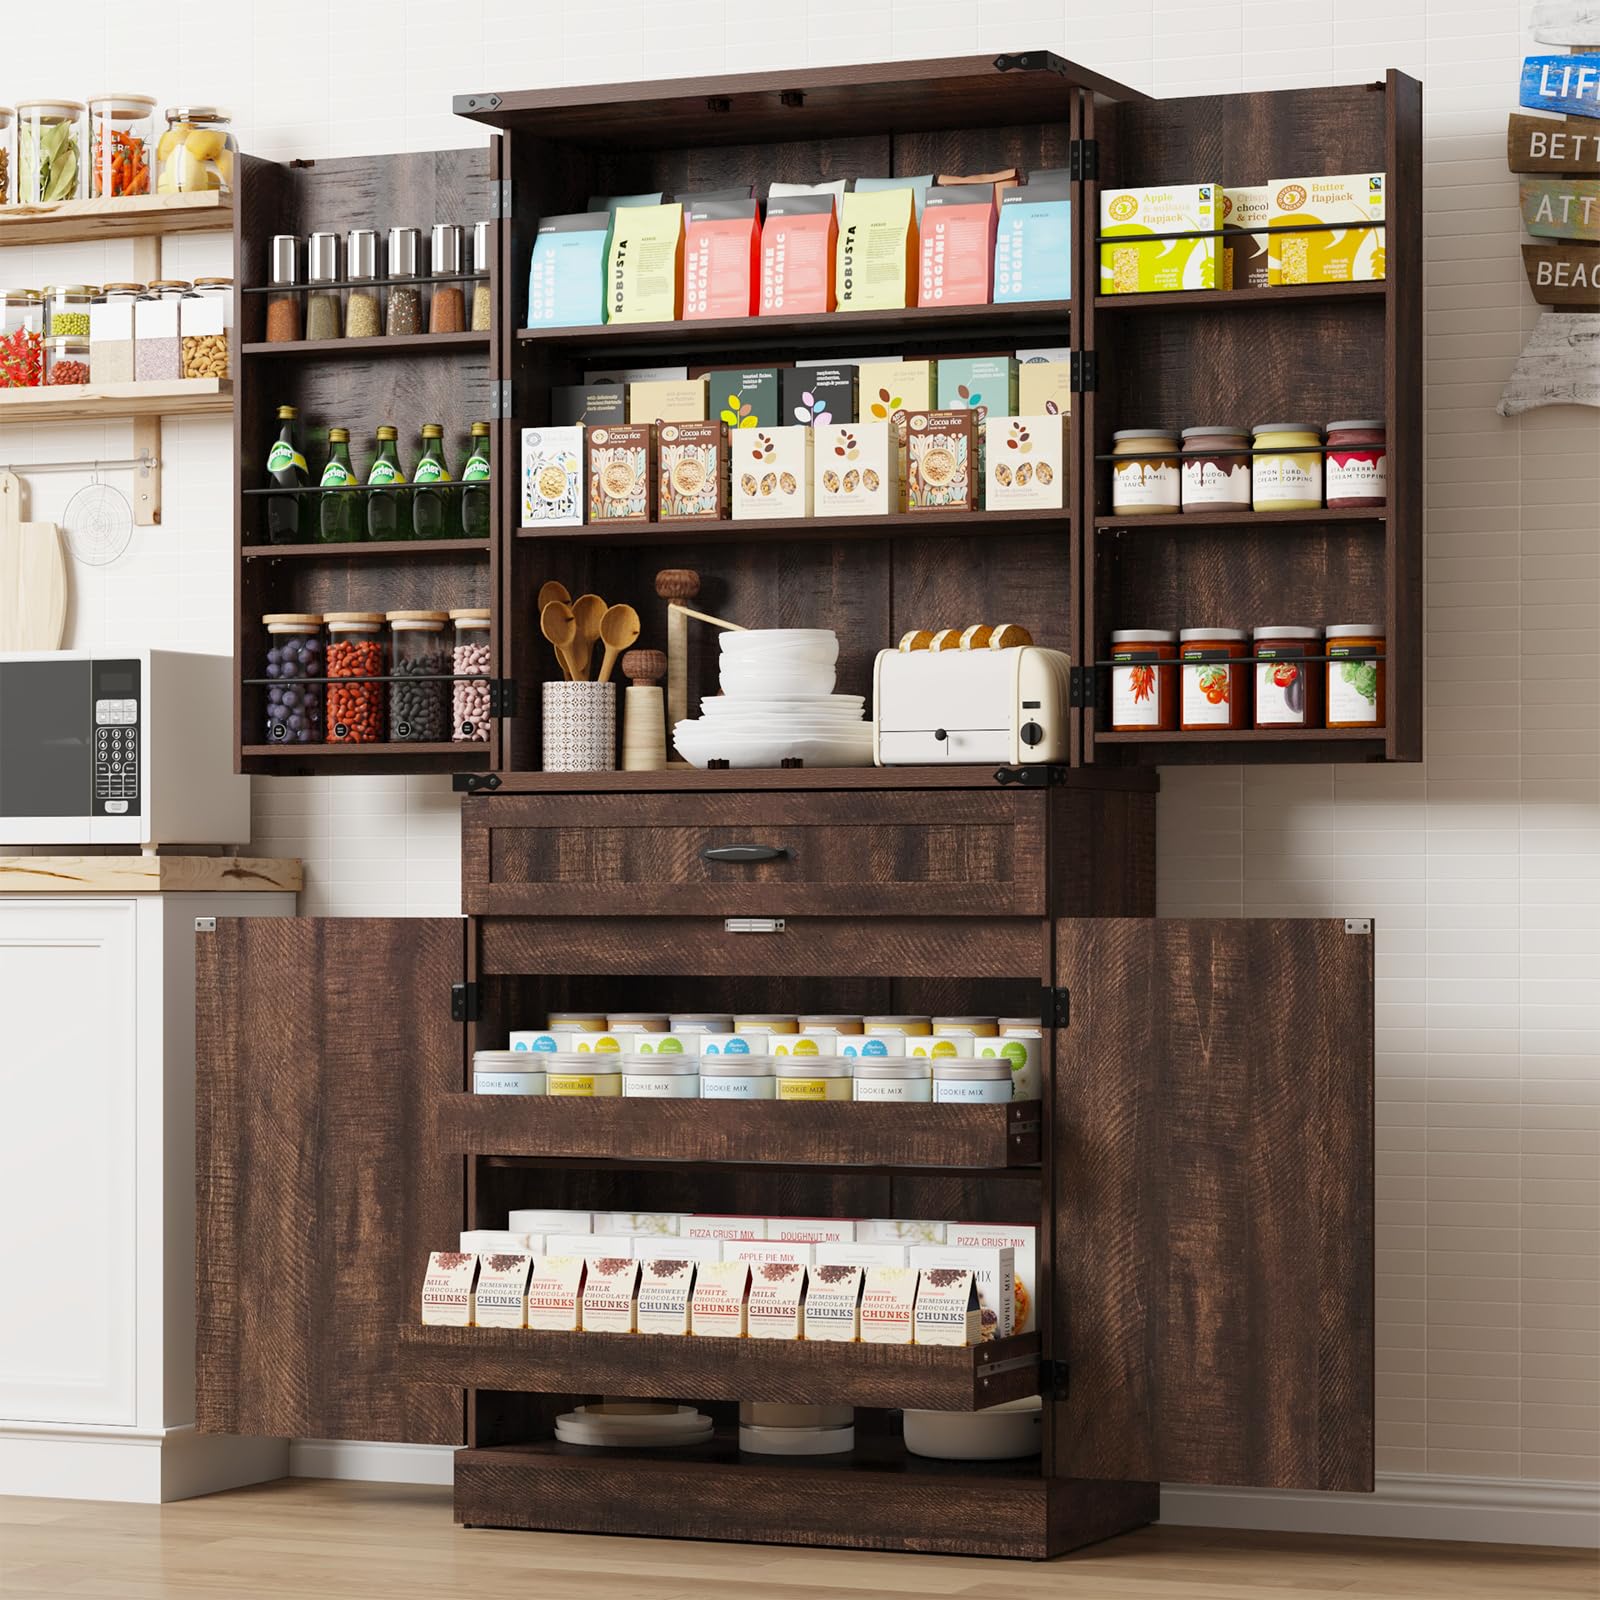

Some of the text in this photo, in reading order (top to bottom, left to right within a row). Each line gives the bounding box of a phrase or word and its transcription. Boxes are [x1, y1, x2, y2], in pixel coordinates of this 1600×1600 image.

[1312, 183, 1345, 192] Butter
[1143, 193, 1173, 203] Apple
[1312, 192, 1353, 204] flapjack
[1535, 194, 1596, 225] ATT
[1143, 214, 1183, 225] flapjack
[1236, 212, 1267, 221] & rice
[1012, 220, 1023, 293] ORGANIC
[844, 226, 857, 300] ROBUSTA
[934, 224, 945, 299] ORGANIC
[1000, 234, 1010, 294] COFFEE
[774, 233, 785, 308] ORGANIC
[923, 238, 934, 300] COFFEE
[615, 239, 628, 313] ROBUSTA
[698, 237, 709, 313] ORGANIC
[764, 248, 774, 309] COFFEE
[688, 252, 698, 313] COFFEE
[929, 418, 950, 426] Cocoa
[610, 432, 641, 441] Cocoa rice
[680, 428, 712, 437] Cocoa rice
[939, 1088, 966, 1096] COOKIE
[689, 1229, 754, 1239] PIZZA CRUST MIX
[780, 1231, 840, 1242] DOUGHNUT MIX
[957, 1237, 1025, 1248] PIZZA CRUST MIX
[739, 1253, 795, 1262] APPLE PIE MIX
[426, 1279, 450, 1287] MILK
[479, 1281, 524, 1289] SEMISWEET
[532, 1283, 563, 1291] WHITE
[478, 1288, 522, 1296] CHOCOLATE
[530, 1290, 576, 1298] CHOCOLATE
[585, 1292, 630, 1300] CHOCOLATE
[751, 1290, 776, 1298] MILK
[424, 1294, 468, 1303] CHUNKS
[477, 1296, 521, 1304] CHUNKS
[530, 1298, 574, 1306] CHUNKS
[694, 1296, 740, 1304] CHOCOLATE
[750, 1298, 796, 1306] CHOCOLATE
[584, 1300, 629, 1309] CHUNKS
[639, 1302, 685, 1311] CHUNKS
[693, 1304, 740, 1313] CHUNKS
[806, 1300, 854, 1308] CHOCOLATE
[862, 1302, 910, 1310] CHOCOLATE
[750, 1306, 796, 1315] CHUNKS
[806, 1308, 853, 1317] CHUNKS
[862, 1310, 910, 1319] CHUNKS
[916, 1312, 964, 1321] CHUNKS
